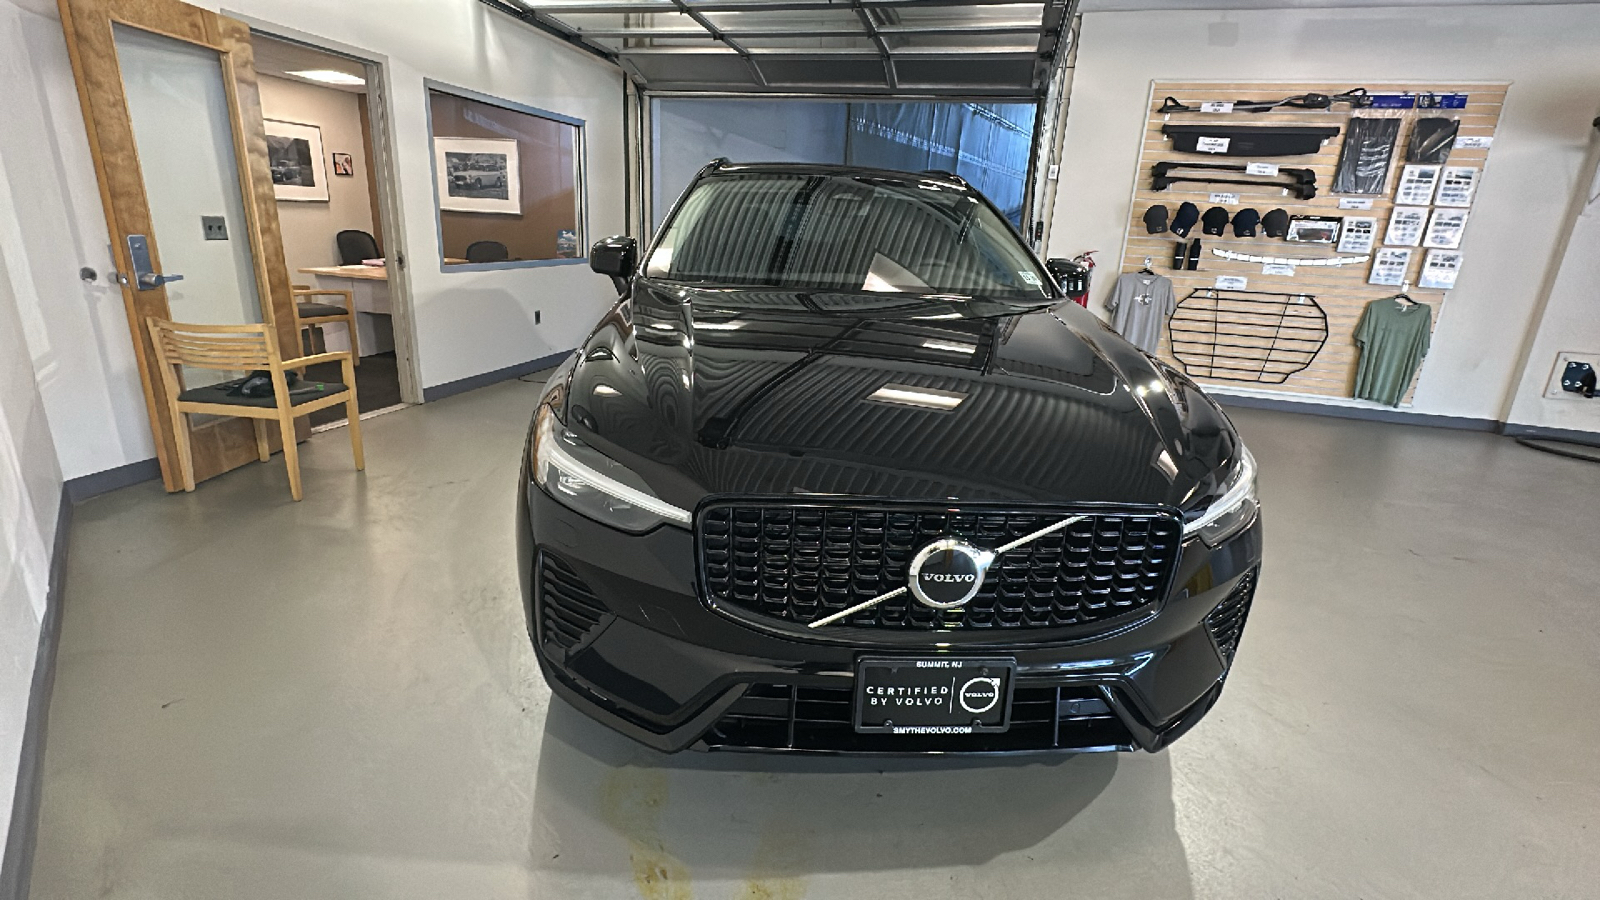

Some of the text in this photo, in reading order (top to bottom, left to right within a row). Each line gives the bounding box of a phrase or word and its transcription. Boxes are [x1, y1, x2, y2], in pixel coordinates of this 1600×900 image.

[921, 573, 975, 583] VOLVO
[866, 686, 949, 695] CERTIFIED
[870, 697, 943, 706] BY VOLVO
[893, 726, 973, 735] SMYTHEVOLVO.COM
